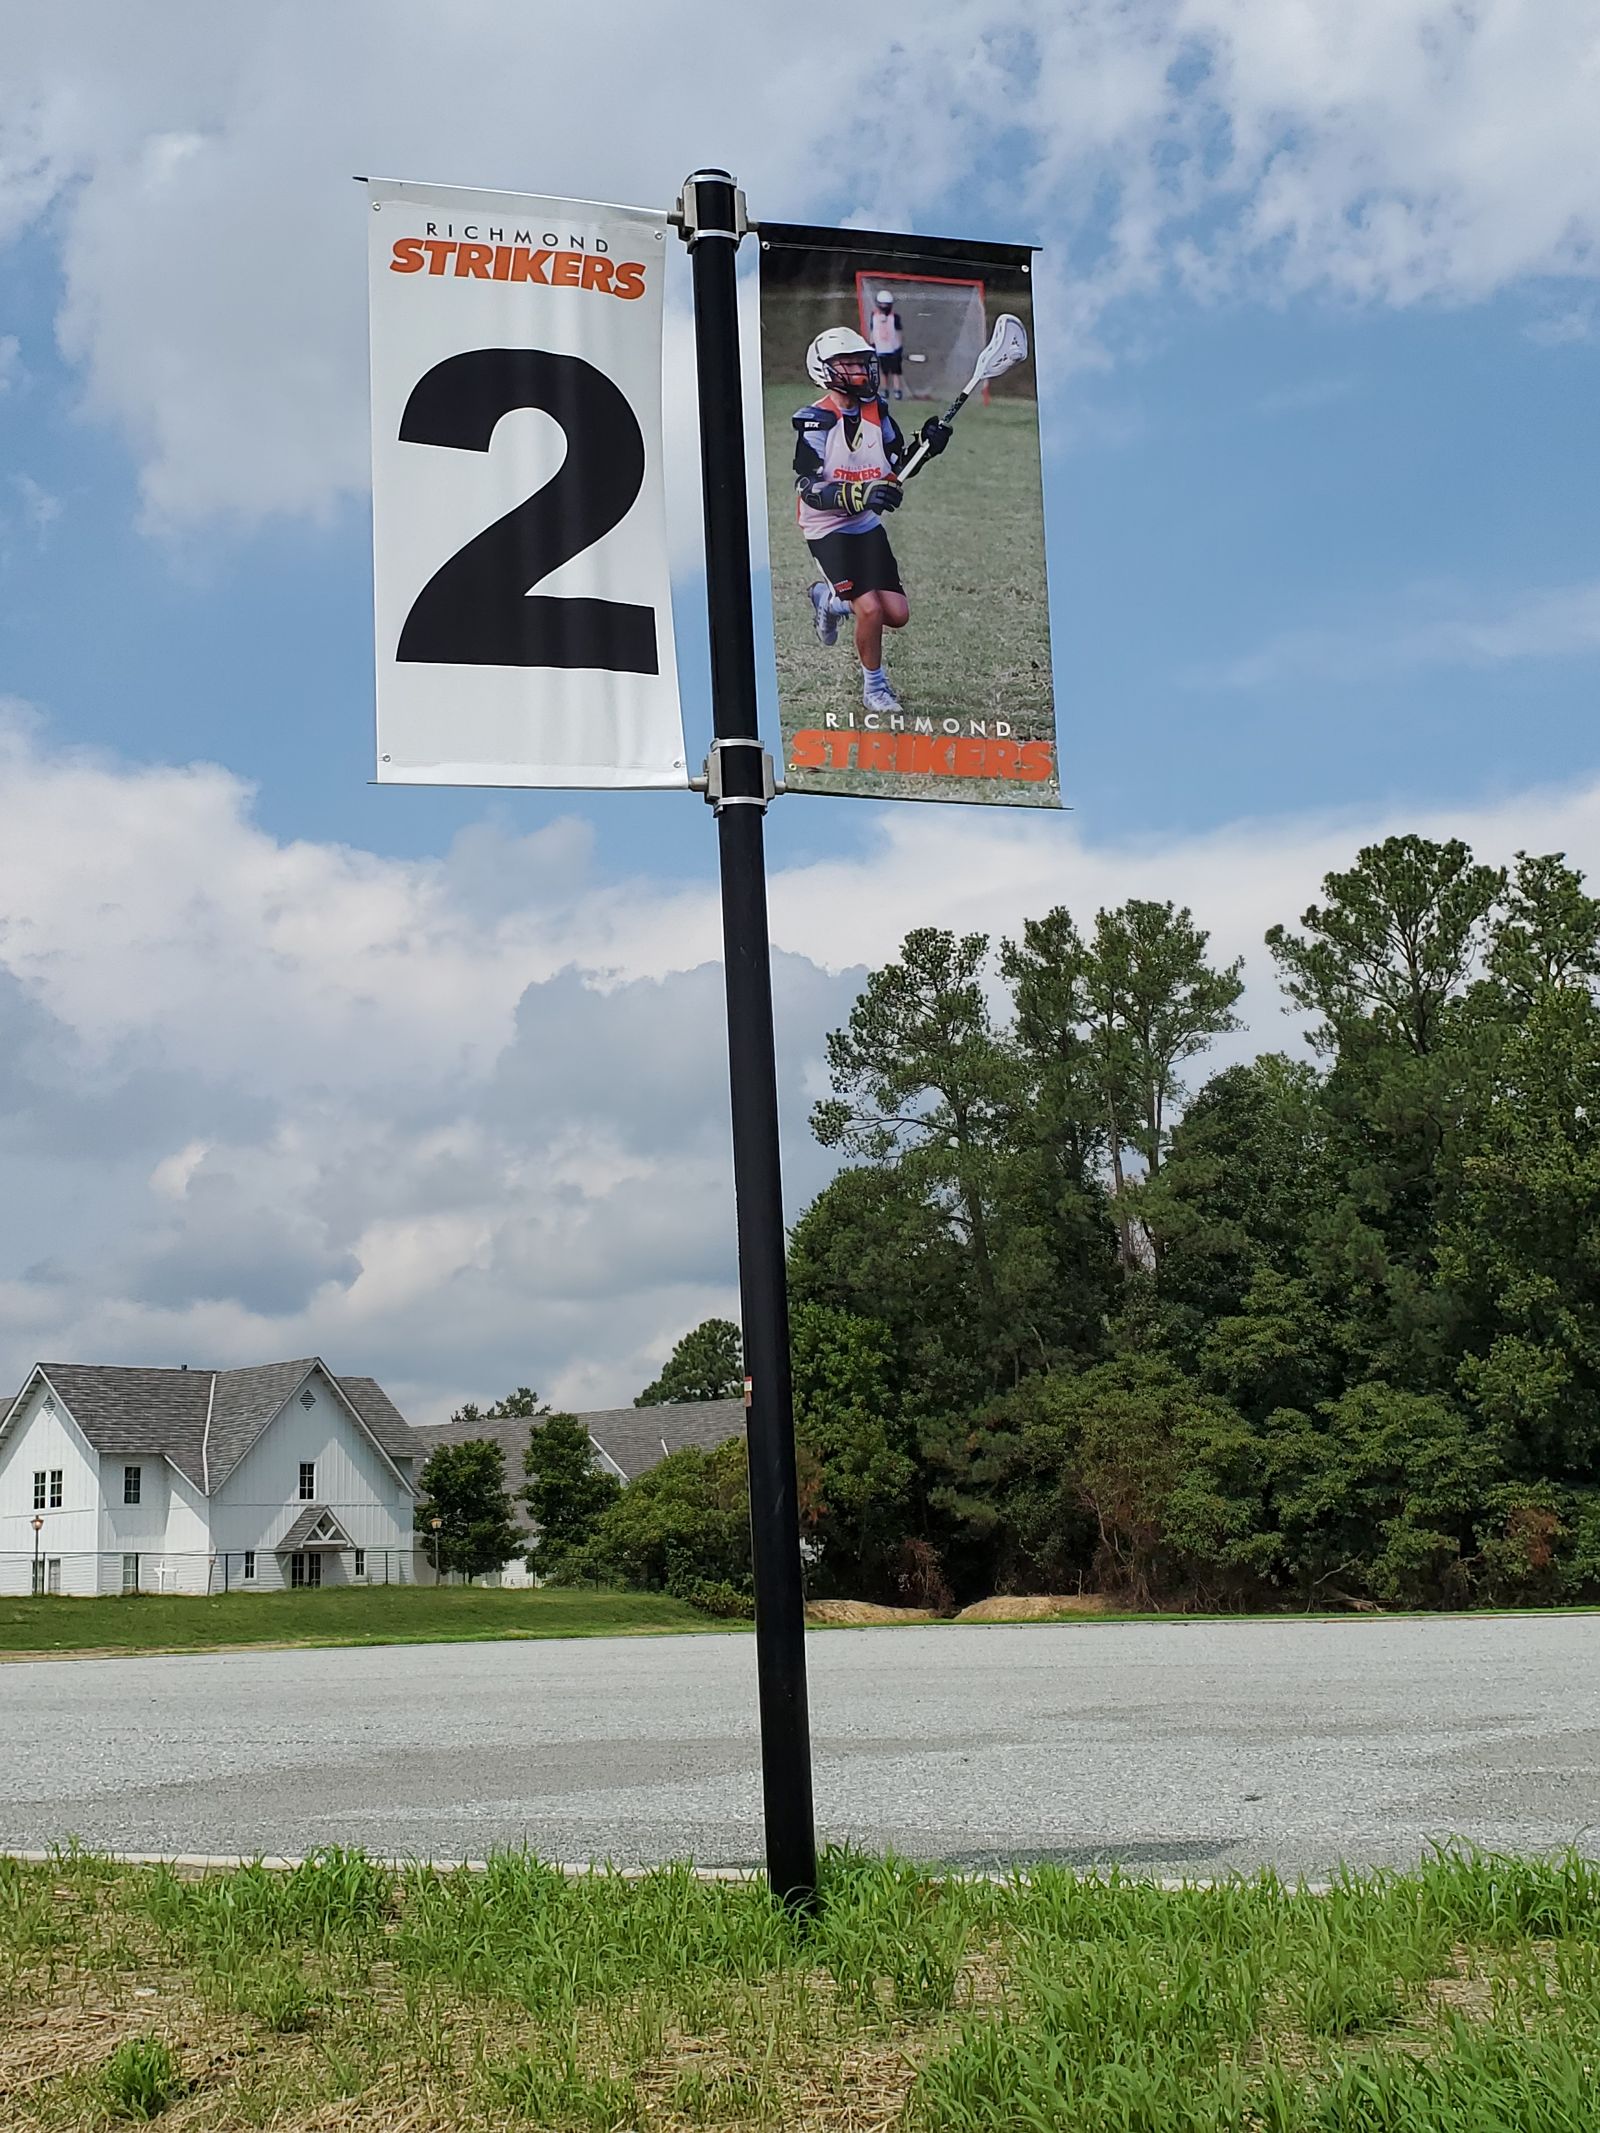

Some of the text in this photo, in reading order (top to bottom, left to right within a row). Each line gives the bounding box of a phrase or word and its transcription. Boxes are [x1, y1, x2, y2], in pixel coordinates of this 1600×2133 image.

[427, 222, 609, 253] RICHMOND
[389, 238, 646, 300] STRIKERS
[833, 467, 881, 482] STRIKERS
[396, 348, 659, 675] 2
[826, 712, 1011, 737] RICHMOND
[789, 729, 1054, 782] STRIKERS
